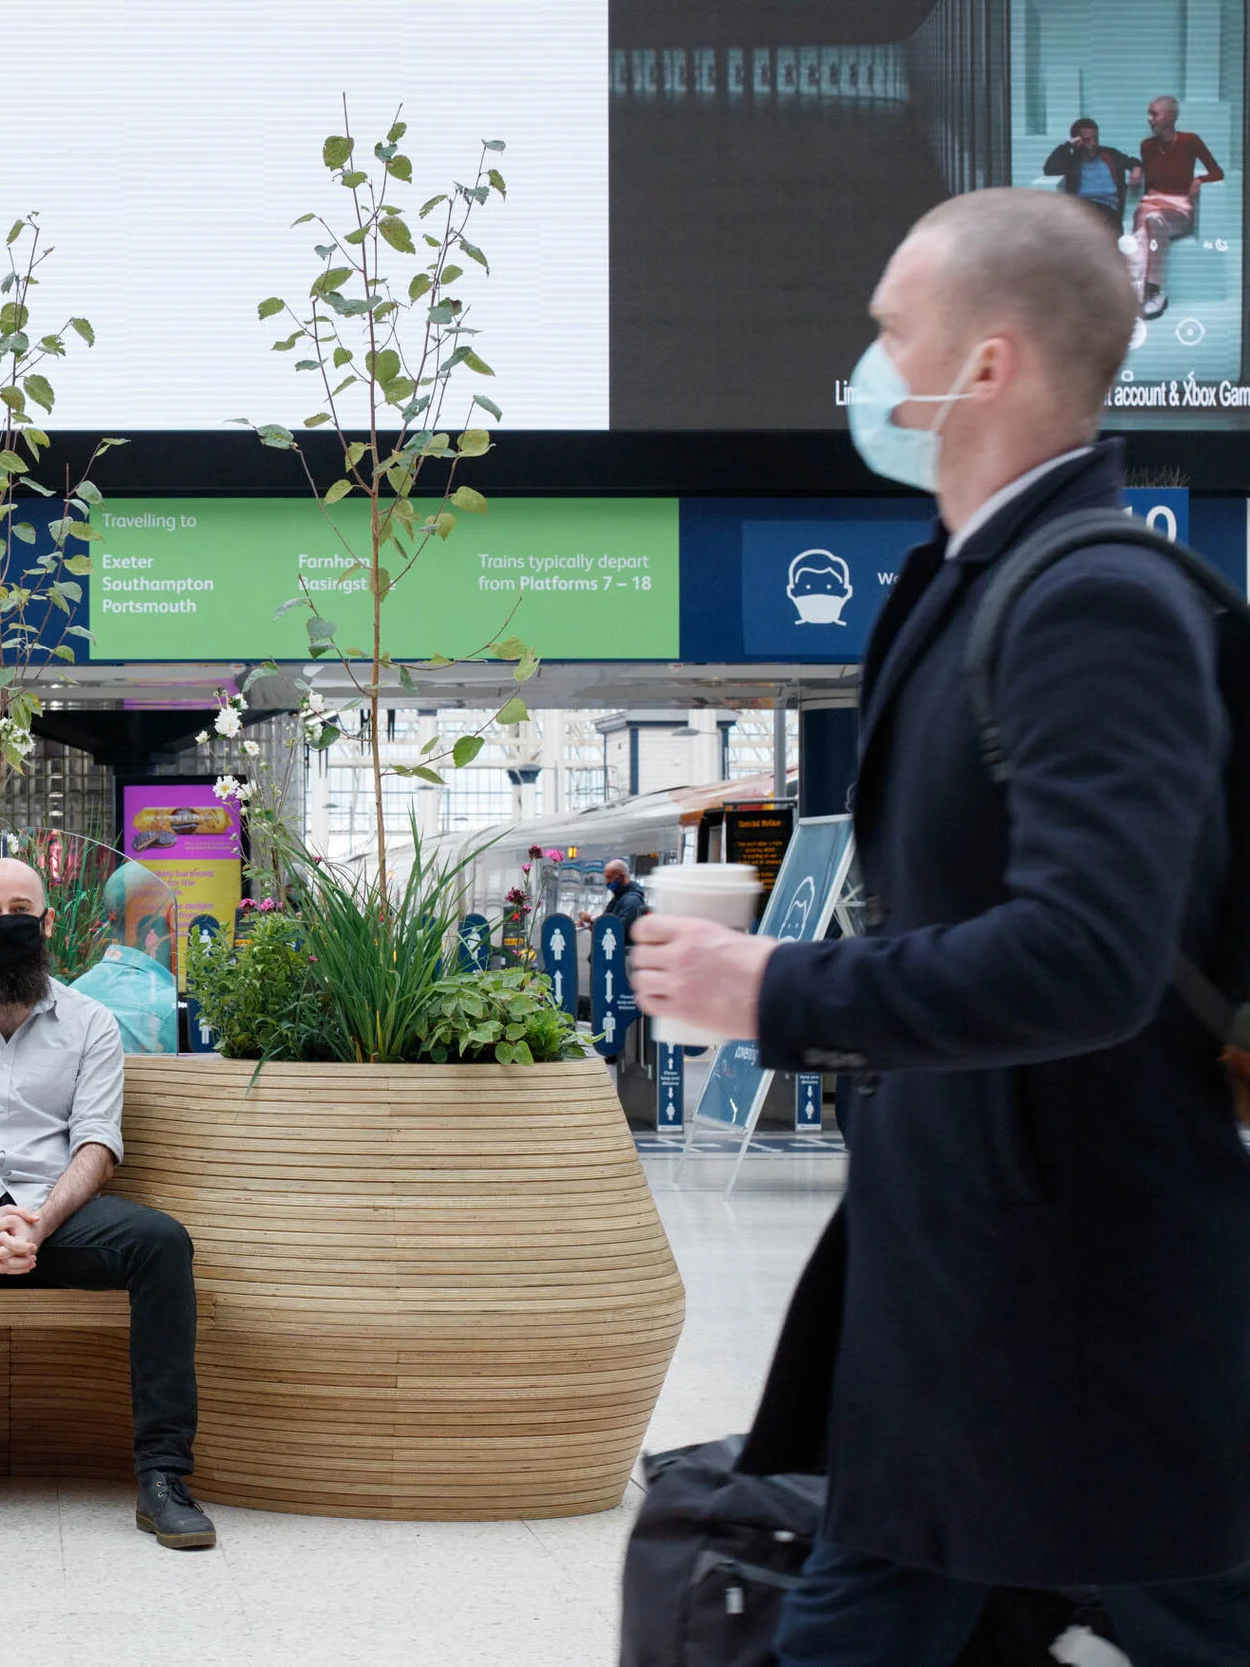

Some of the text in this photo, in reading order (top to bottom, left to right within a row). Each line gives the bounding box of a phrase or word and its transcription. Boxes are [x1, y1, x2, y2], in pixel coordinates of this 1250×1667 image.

[1114, 383, 1168, 407] account
[1169, 382, 1182, 407] &
[1183, 380, 1217, 407] Xbox
[102, 513, 197, 531] Travelling to
[1122, 505, 1178, 545] 0
[102, 554, 154, 569] Exeter
[478, 553, 649, 572] Trains typically depart
[102, 577, 214, 595] Southampton
[478, 576, 516, 591] from
[519, 576, 599, 591] Platforms
[602, 576, 614, 591] 7
[631, 576, 652, 591] 18
[102, 599, 197, 614] Portsmouth
